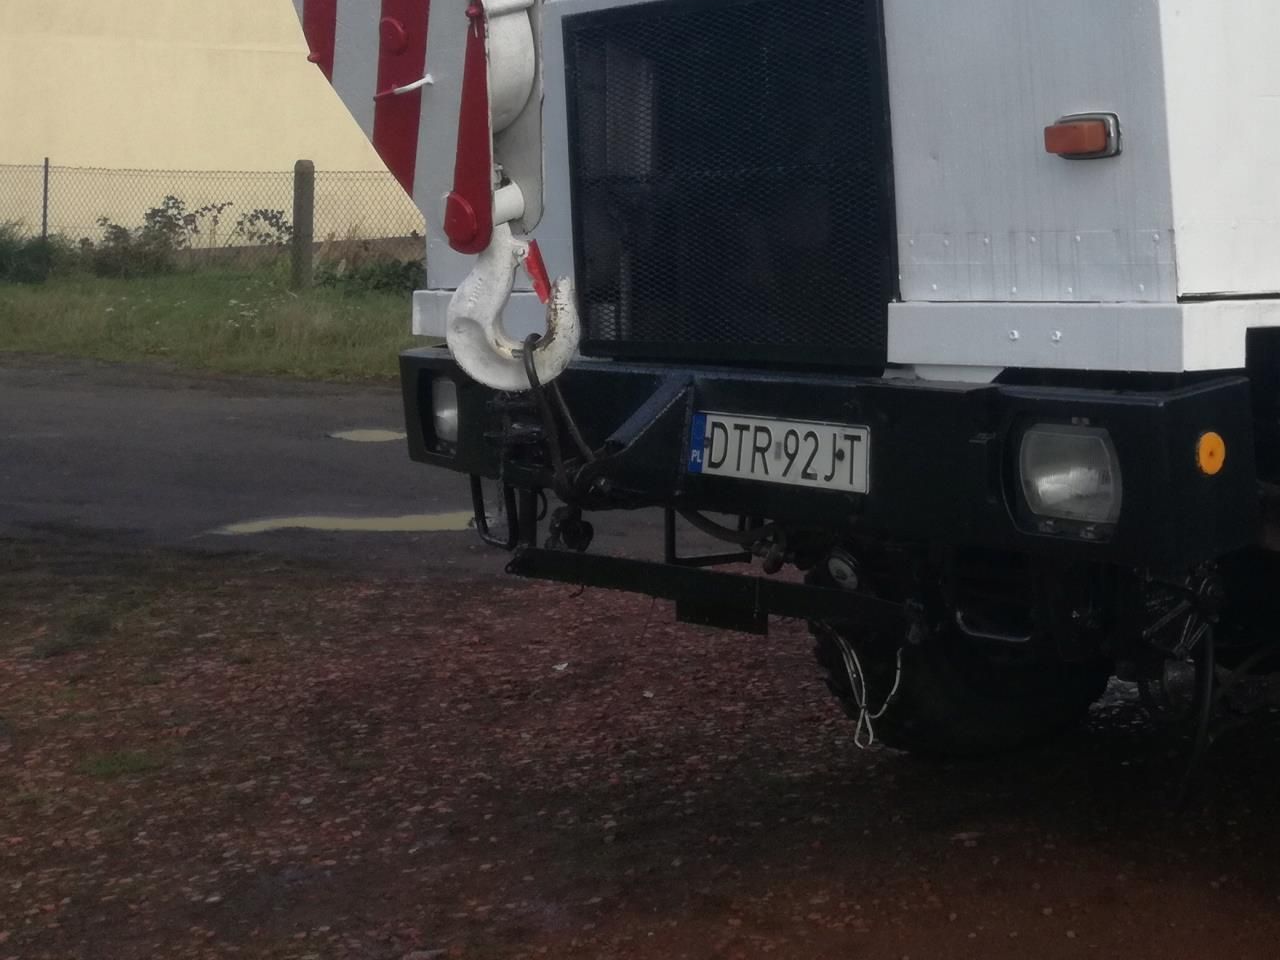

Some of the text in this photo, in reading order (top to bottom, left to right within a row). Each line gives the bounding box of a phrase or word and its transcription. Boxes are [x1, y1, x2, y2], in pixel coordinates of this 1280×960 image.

[690, 449, 702, 463] PL
[707, 421, 862, 485] DTR 92JT
